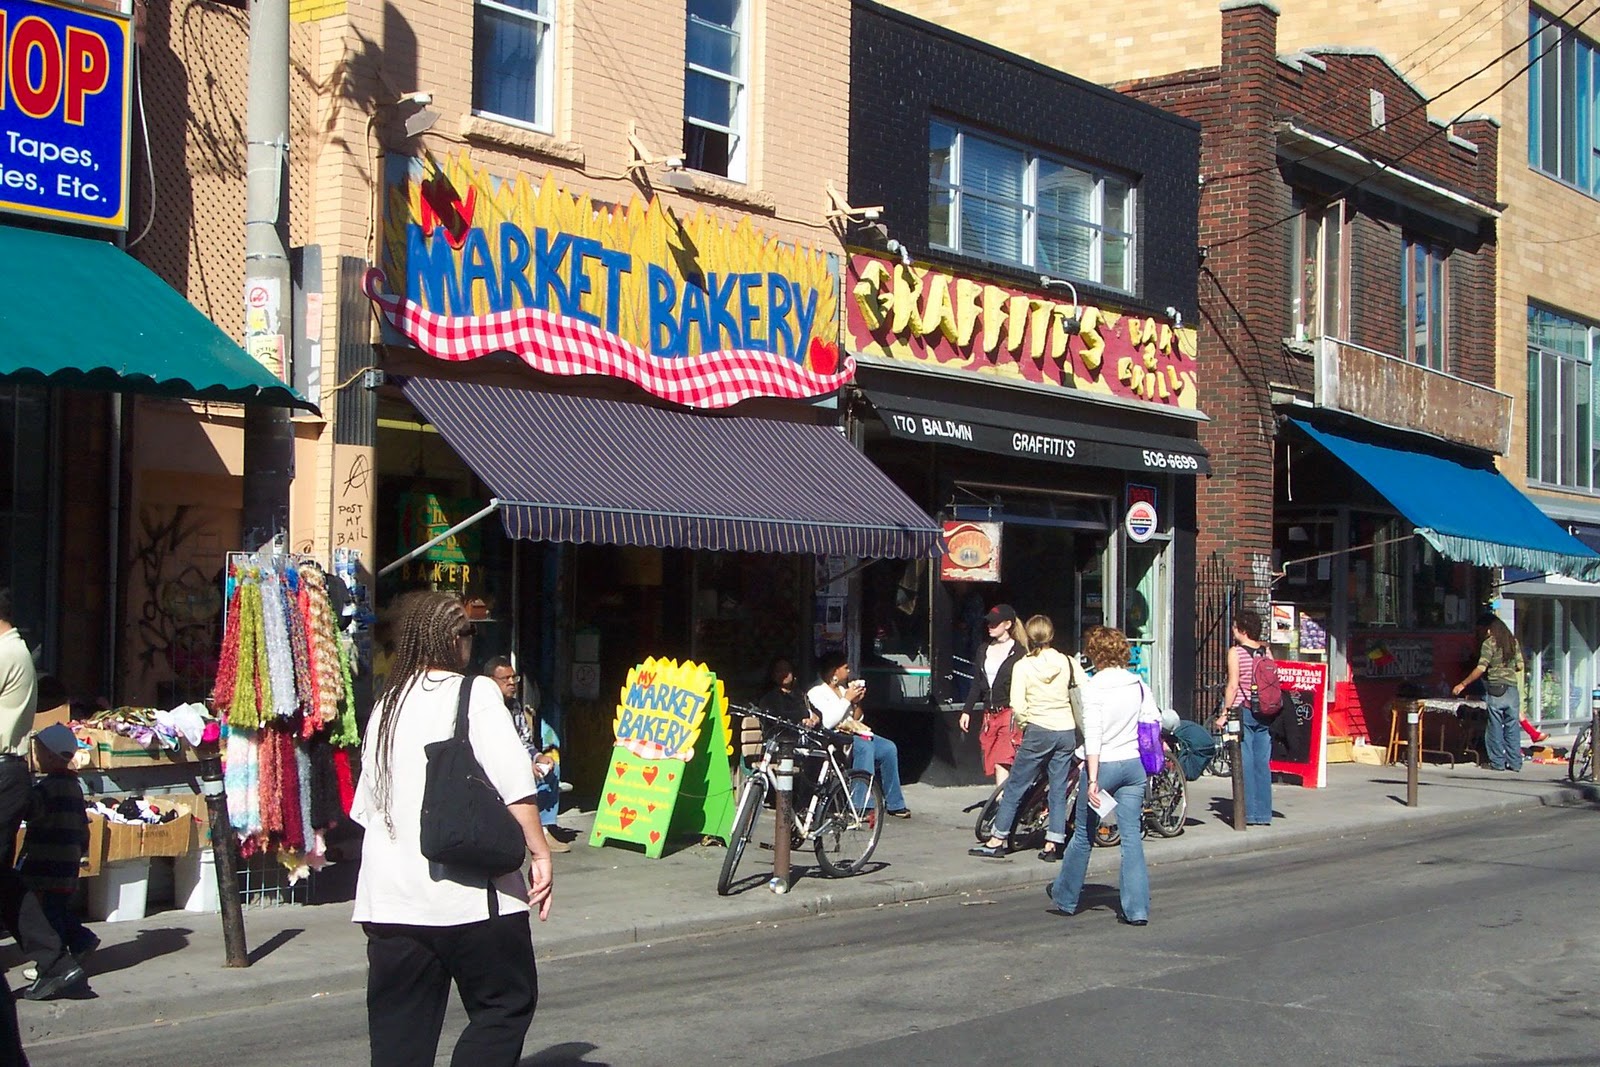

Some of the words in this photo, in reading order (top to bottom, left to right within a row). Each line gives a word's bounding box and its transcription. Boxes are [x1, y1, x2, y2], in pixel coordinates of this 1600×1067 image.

[0, 10, 109, 126] OP
[7, 131, 99, 171] Tapes,
[57, 174, 107, 202] Etc.
[407, 222, 631, 336] MARKET
[649, 262, 818, 365] BAKERY
[1128, 317, 1172, 355] BAR
[1118, 357, 1182, 399] GRILL
[893, 415, 916, 434] 170
[922, 418, 973, 441] BALDWIN
[1013, 432, 1076, 458] GRAFFITI'S
[1143, 450, 1198, 469] 506-6699
[338, 503, 364, 514] POST
[346, 516, 361, 527] MY
[1295, 676, 1322, 684] BEERS
[625, 682, 705, 725] MARKET
[617, 709, 693, 757] BAKERY
